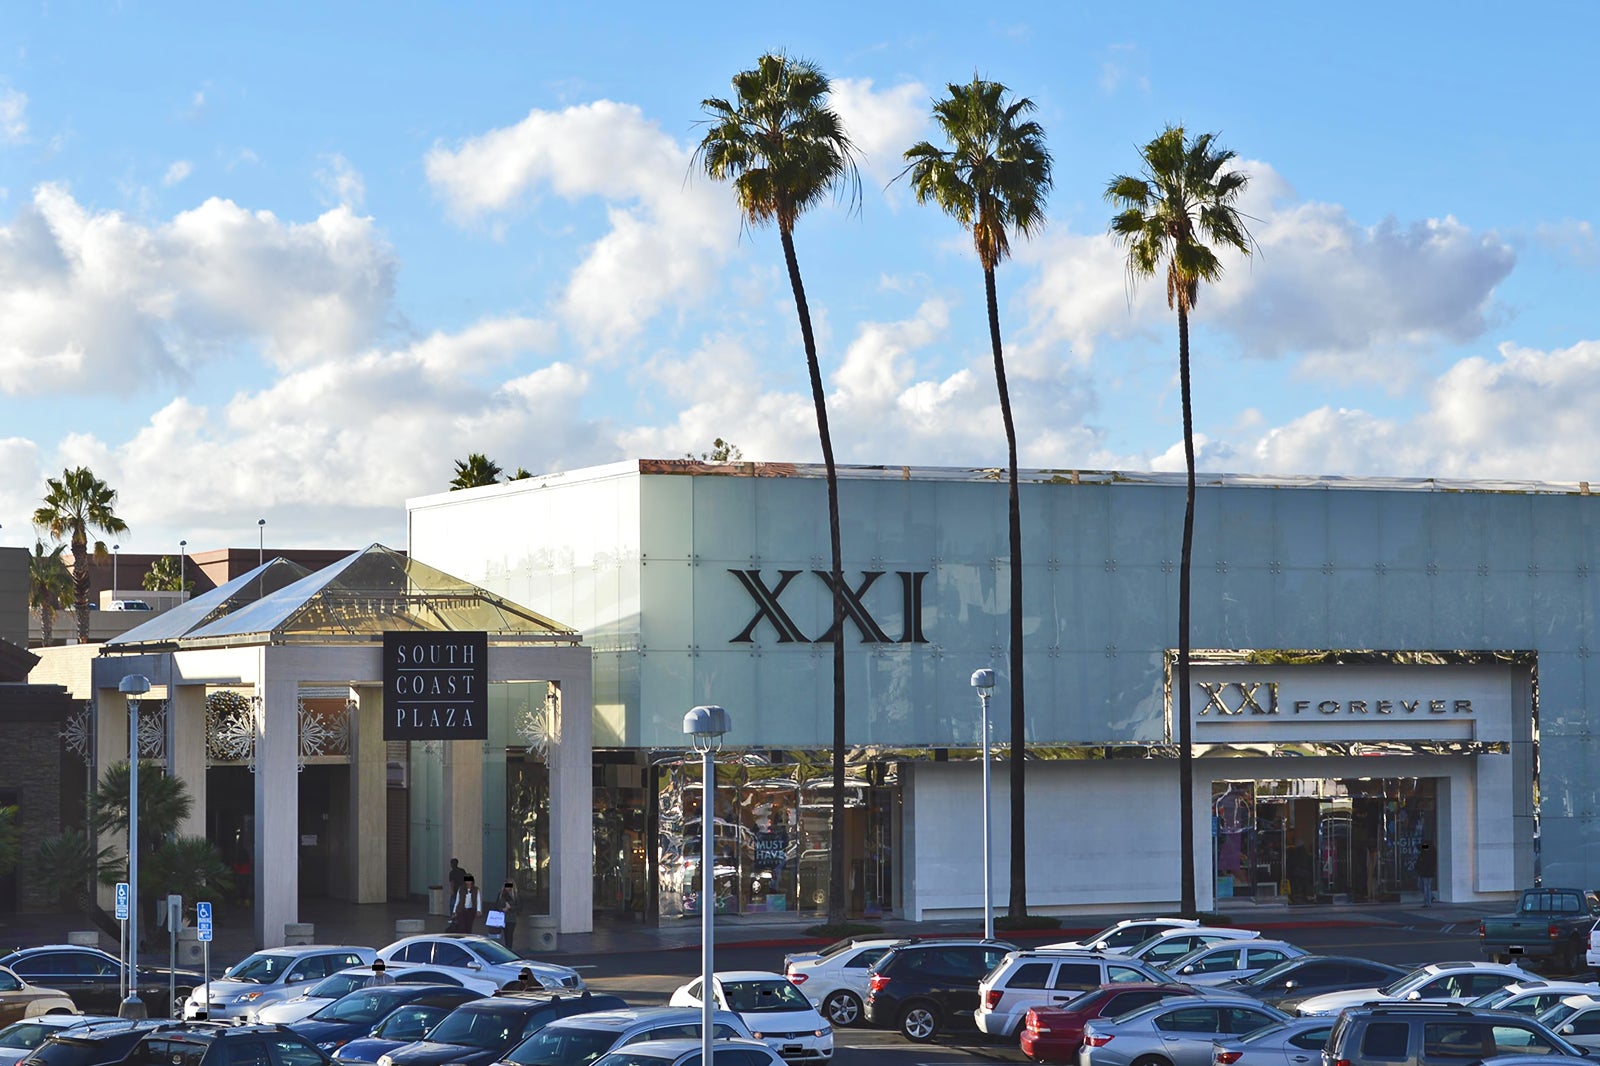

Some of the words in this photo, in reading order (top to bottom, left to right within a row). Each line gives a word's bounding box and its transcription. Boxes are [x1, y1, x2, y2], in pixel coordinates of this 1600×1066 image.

[727, 569, 930, 644] XXI
[397, 644, 474, 664] SOUTH
[396, 675, 475, 694] COAST
[1198, 681, 1280, 715] XXI
[1294, 700, 1474, 714] FOREVER
[397, 708, 473, 728] PLAZA
[756, 840, 784, 849] MUST
[756, 850, 785, 860] HAVE
